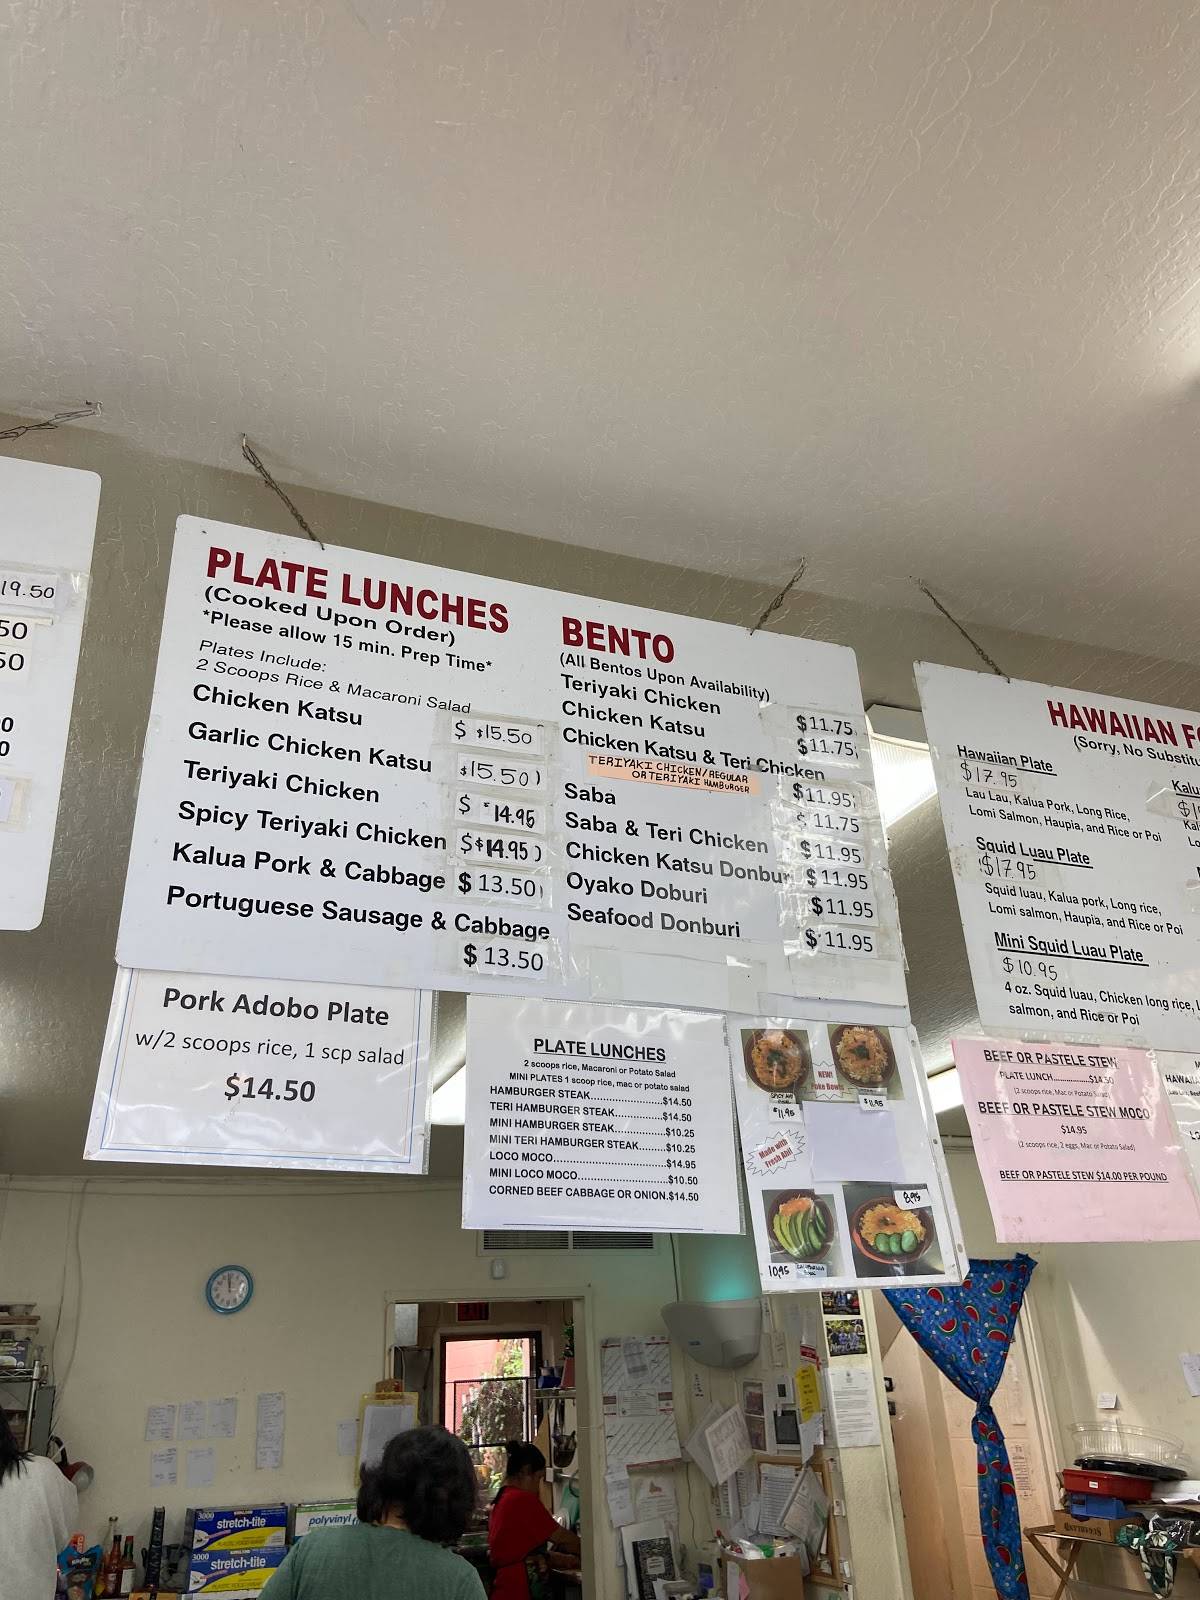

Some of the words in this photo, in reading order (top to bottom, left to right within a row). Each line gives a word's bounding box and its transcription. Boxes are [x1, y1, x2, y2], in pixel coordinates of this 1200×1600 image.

[207, 546, 328, 600] PLATE
[341, 573, 509, 634] LUNCHES
[204, 585, 307, 617] (Cooked
[316, 606, 377, 630] Upon
[385, 620, 455, 647] Order)
[278, 625, 327, 644] allow
[333, 633, 352, 649] 15
[358, 641, 395, 657] min.
[401, 645, 440, 667] Prep
[562, 616, 674, 663] BENTO
[199, 639, 255, 660] Plates
[260, 650, 327, 672] Include:
[213, 661, 280, 683] Scoops
[285, 672, 323, 690] Rice
[347, 683, 422, 706] Macaroni
[426, 696, 471, 714] Salad
[560, 652, 586, 668] (All
[590, 657, 642, 678] Bentos
[647, 667, 685, 686] Upon
[689, 675, 770, 703] Availability)
[193, 684, 289, 715] Chicken
[298, 700, 363, 726] Katsu
[796, 712, 853, 736] $11.75
[1046, 700, 1178, 747] HAWAIIAN
[188, 721, 260, 748] Garlic
[268, 733, 361, 763] Chicken
[369, 747, 432, 773] Katsu
[563, 727, 639, 753] Chicken
[644, 739, 697, 763] Katsu
[797, 737, 857, 756] $11.75
[956, 744, 1018, 767] Hawaiian
[1019, 755, 1053, 772] Plate
[1073, 735, 1121, 756] (Sorry,
[1123, 743, 1143, 757] No
[183, 759, 278, 790] Teriyaki
[286, 774, 379, 803] Chicken
[564, 782, 616, 805] Saba
[965, 786, 986, 800] Lau
[988, 790, 1012, 805] Lau,
[1013, 793, 1045, 809] Kalua
[1046, 799, 1075, 814] Pork,
[1075, 803, 1103, 819] Long
[1103, 807, 1131, 823] Rice,
[178, 800, 249, 832] Spicy
[256, 809, 348, 839] Teriyaki
[356, 822, 447, 850] Chicken
[565, 811, 617, 834] Saba
[645, 821, 682, 843] Teri
[689, 828, 769, 854] Chicken
[968, 804, 996, 819] Lomi
[998, 809, 1043, 827] Salmon,
[1043, 815, 1084, 833] Haupia,
[1106, 824, 1130, 838] Rice
[1144, 829, 1162, 842] Poi
[566, 841, 650, 868] Chicken
[656, 852, 713, 876] Katsu
[976, 836, 1017, 855] Squid
[1019, 842, 1054, 860] Luau
[1056, 847, 1090, 865] Plate
[172, 842, 246, 868] Kalua
[254, 851, 311, 876] Pork
[345, 861, 446, 893] Cabbage
[566, 871, 634, 896] Oyako
[640, 879, 708, 904] Doburi
[984, 882, 1017, 898] Squid
[1018, 886, 1046, 902] luau,
[166, 885, 314, 918] Portuguese
[322, 900, 423, 932] Sausage
[454, 913, 550, 942] Cabbage
[567, 903, 653, 929] Seafood
[660, 912, 740, 938] Donburi
[994, 931, 1025, 949] Mini
[1028, 935, 1069, 954] Squid
[163, 987, 226, 1012] Pork
[231, 994, 319, 1020] Adobo
[327, 1001, 389, 1026] Plate
[1014, 985, 1032, 995] oz.
[1034, 983, 1067, 1000] Squid
[1069, 987, 1097, 1003] luau,
[135, 1029, 176, 1050] w/2
[182, 1036, 251, 1056] scoops
[257, 1038, 297, 1060] rice,
[321, 1047, 352, 1065] scp
[357, 1047, 404, 1066] salad
[534, 1038, 587, 1055] PLATE
[590, 1042, 666, 1061] LUNCHES
[983, 1049, 1018, 1063] BEEF
[1036, 1053, 1086, 1066] PASTELE
[509, 1072, 528, 1081] MINI
[530, 1073, 563, 1083] PLATES
[571, 1078, 596, 1087] scoop
[597, 1078, 615, 1088] rice,
[644, 1082, 669, 1091] potato
[670, 1084, 690, 1093] salad
[531, 1061, 560, 1071] scoops
[562, 1062, 580, 1072] rice,
[581, 1063, 617, 1073] Macaroni
[629, 1067, 654, 1076] Potato
[655, 1069, 676, 1078] Salad
[224, 1072, 316, 1102] $14.50
[490, 1085, 556, 1098] HAMBURGER
[489, 1101, 513, 1111] TERI
[515, 1103, 580, 1115] HAMBURGER
[1031, 1103, 1085, 1118] PASTELE
[1086, 1105, 1117, 1119] STEW
[1060, 1123, 1088, 1135] $14.95
[489, 1151, 519, 1161] LOCO
[489, 1167, 512, 1178] MINI
[999, 1170, 1020, 1179] BEEF
[1036, 1170, 1071, 1180] PASTELE
[1071, 1171, 1094, 1180] STEW
[1096, 1171, 1122, 1181] $14.00
[1123, 1172, 1139, 1181] PER
[1139, 1172, 1167, 1181] POUND
[489, 1185, 534, 1196] CORNED
[536, 1186, 563, 1197] BEEF
[565, 1187, 615, 1199] CABBAGE
[216, 1517, 266, 1530] stretch-tite
[308, 1514, 351, 1527] polyvinyl
[192, 1553, 209, 1562] 3000
[211, 1556, 266, 1570] stretch-tite
